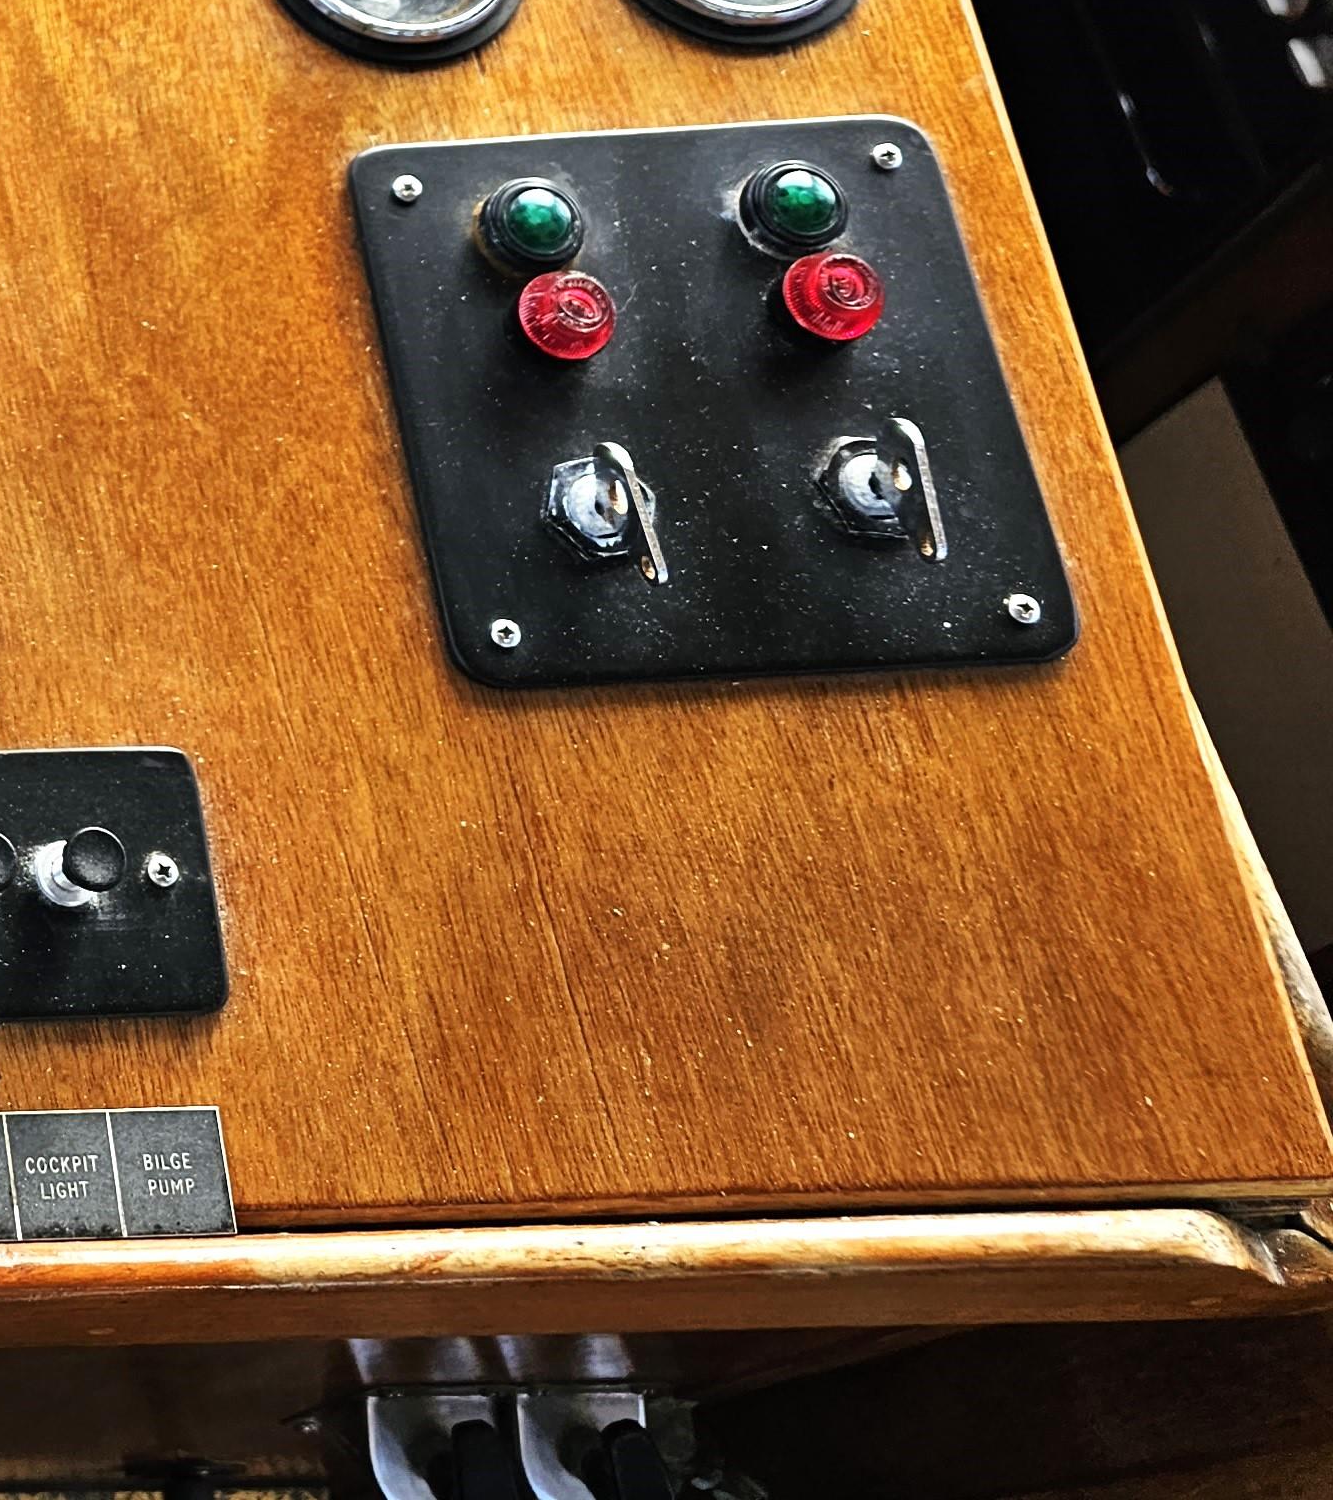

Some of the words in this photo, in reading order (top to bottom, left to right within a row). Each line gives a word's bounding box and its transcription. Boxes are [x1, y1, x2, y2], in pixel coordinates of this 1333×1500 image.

[25, 1154, 99, 1175] COCKPIT
[142, 1152, 193, 1171] BILGE
[40, 1180, 90, 1200] LIGHT
[147, 1178, 195, 1196] PUMP
